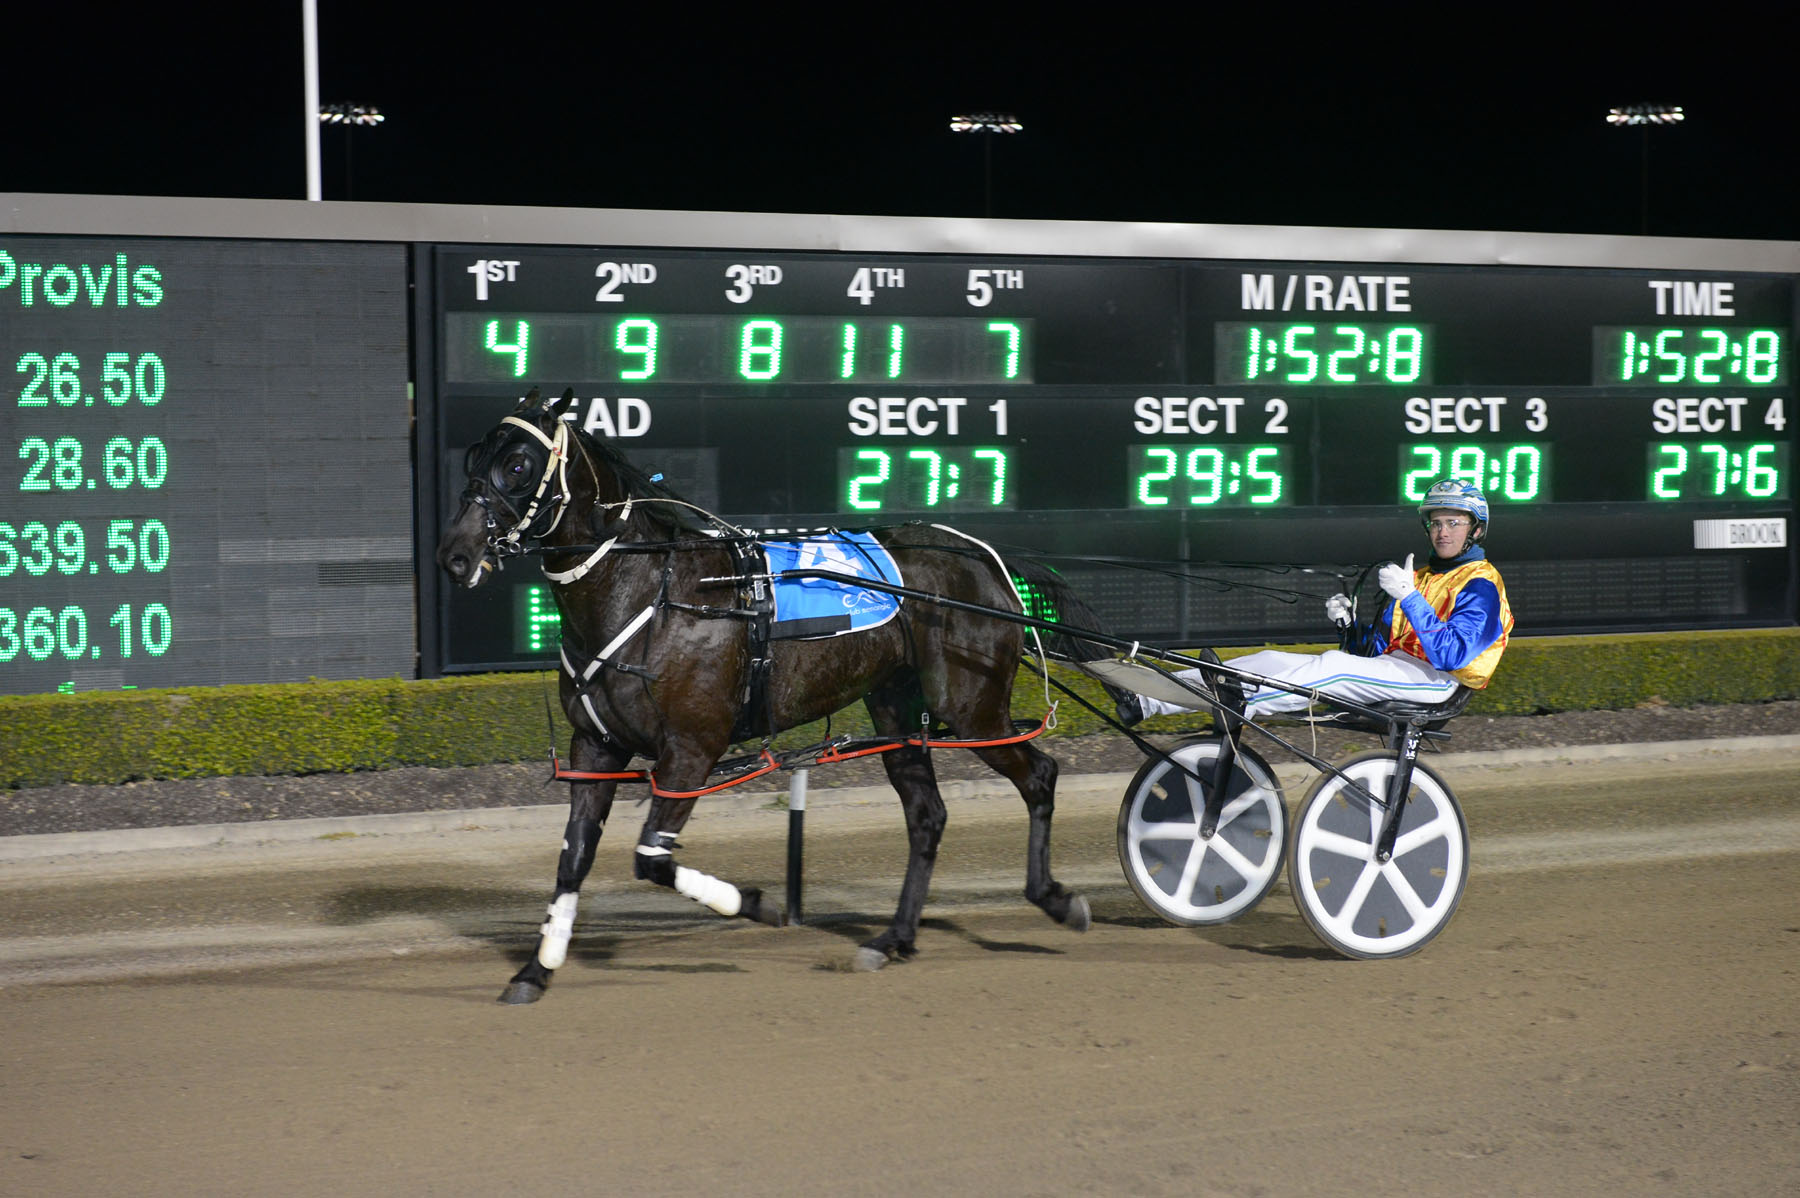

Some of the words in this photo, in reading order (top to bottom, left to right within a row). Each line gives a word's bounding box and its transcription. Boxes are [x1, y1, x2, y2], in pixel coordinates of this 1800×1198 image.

[467, 260, 521, 301] 1ST
[596, 262, 657, 303] 2ND
[726, 265, 783, 304] 3RD
[847, 268, 905, 307] 4TH
[967, 270, 1024, 308] 5TH
[1648, 281, 1736, 318] TIME
[485, 320, 531, 378] 4
[615, 318, 660, 382] 9
[739, 319, 785, 382] 8
[987, 322, 1022, 381] 7
[1245, 325, 1424, 385] 1:52:8
[1620, 330, 1781, 385] 1:52:8
[17, 353, 166, 407] 26.50
[520, 398, 652, 437] AD
[849, 397, 968, 437] SECT
[989, 400, 1009, 437] 1
[1134, 397, 1246, 435] SECT
[1265, 399, 1290, 435] 2
[1405, 397, 1508, 434] SECT
[1526, 398, 1549, 433] 3
[1652, 398, 1749, 434] SECT
[1765, 399, 1786, 432] 4
[19, 438, 168, 492] 28.60
[848, 449, 1008, 512] 27:7
[1138, 447, 1283, 507] 29:5
[1652, 444, 1779, 500] 27:6
